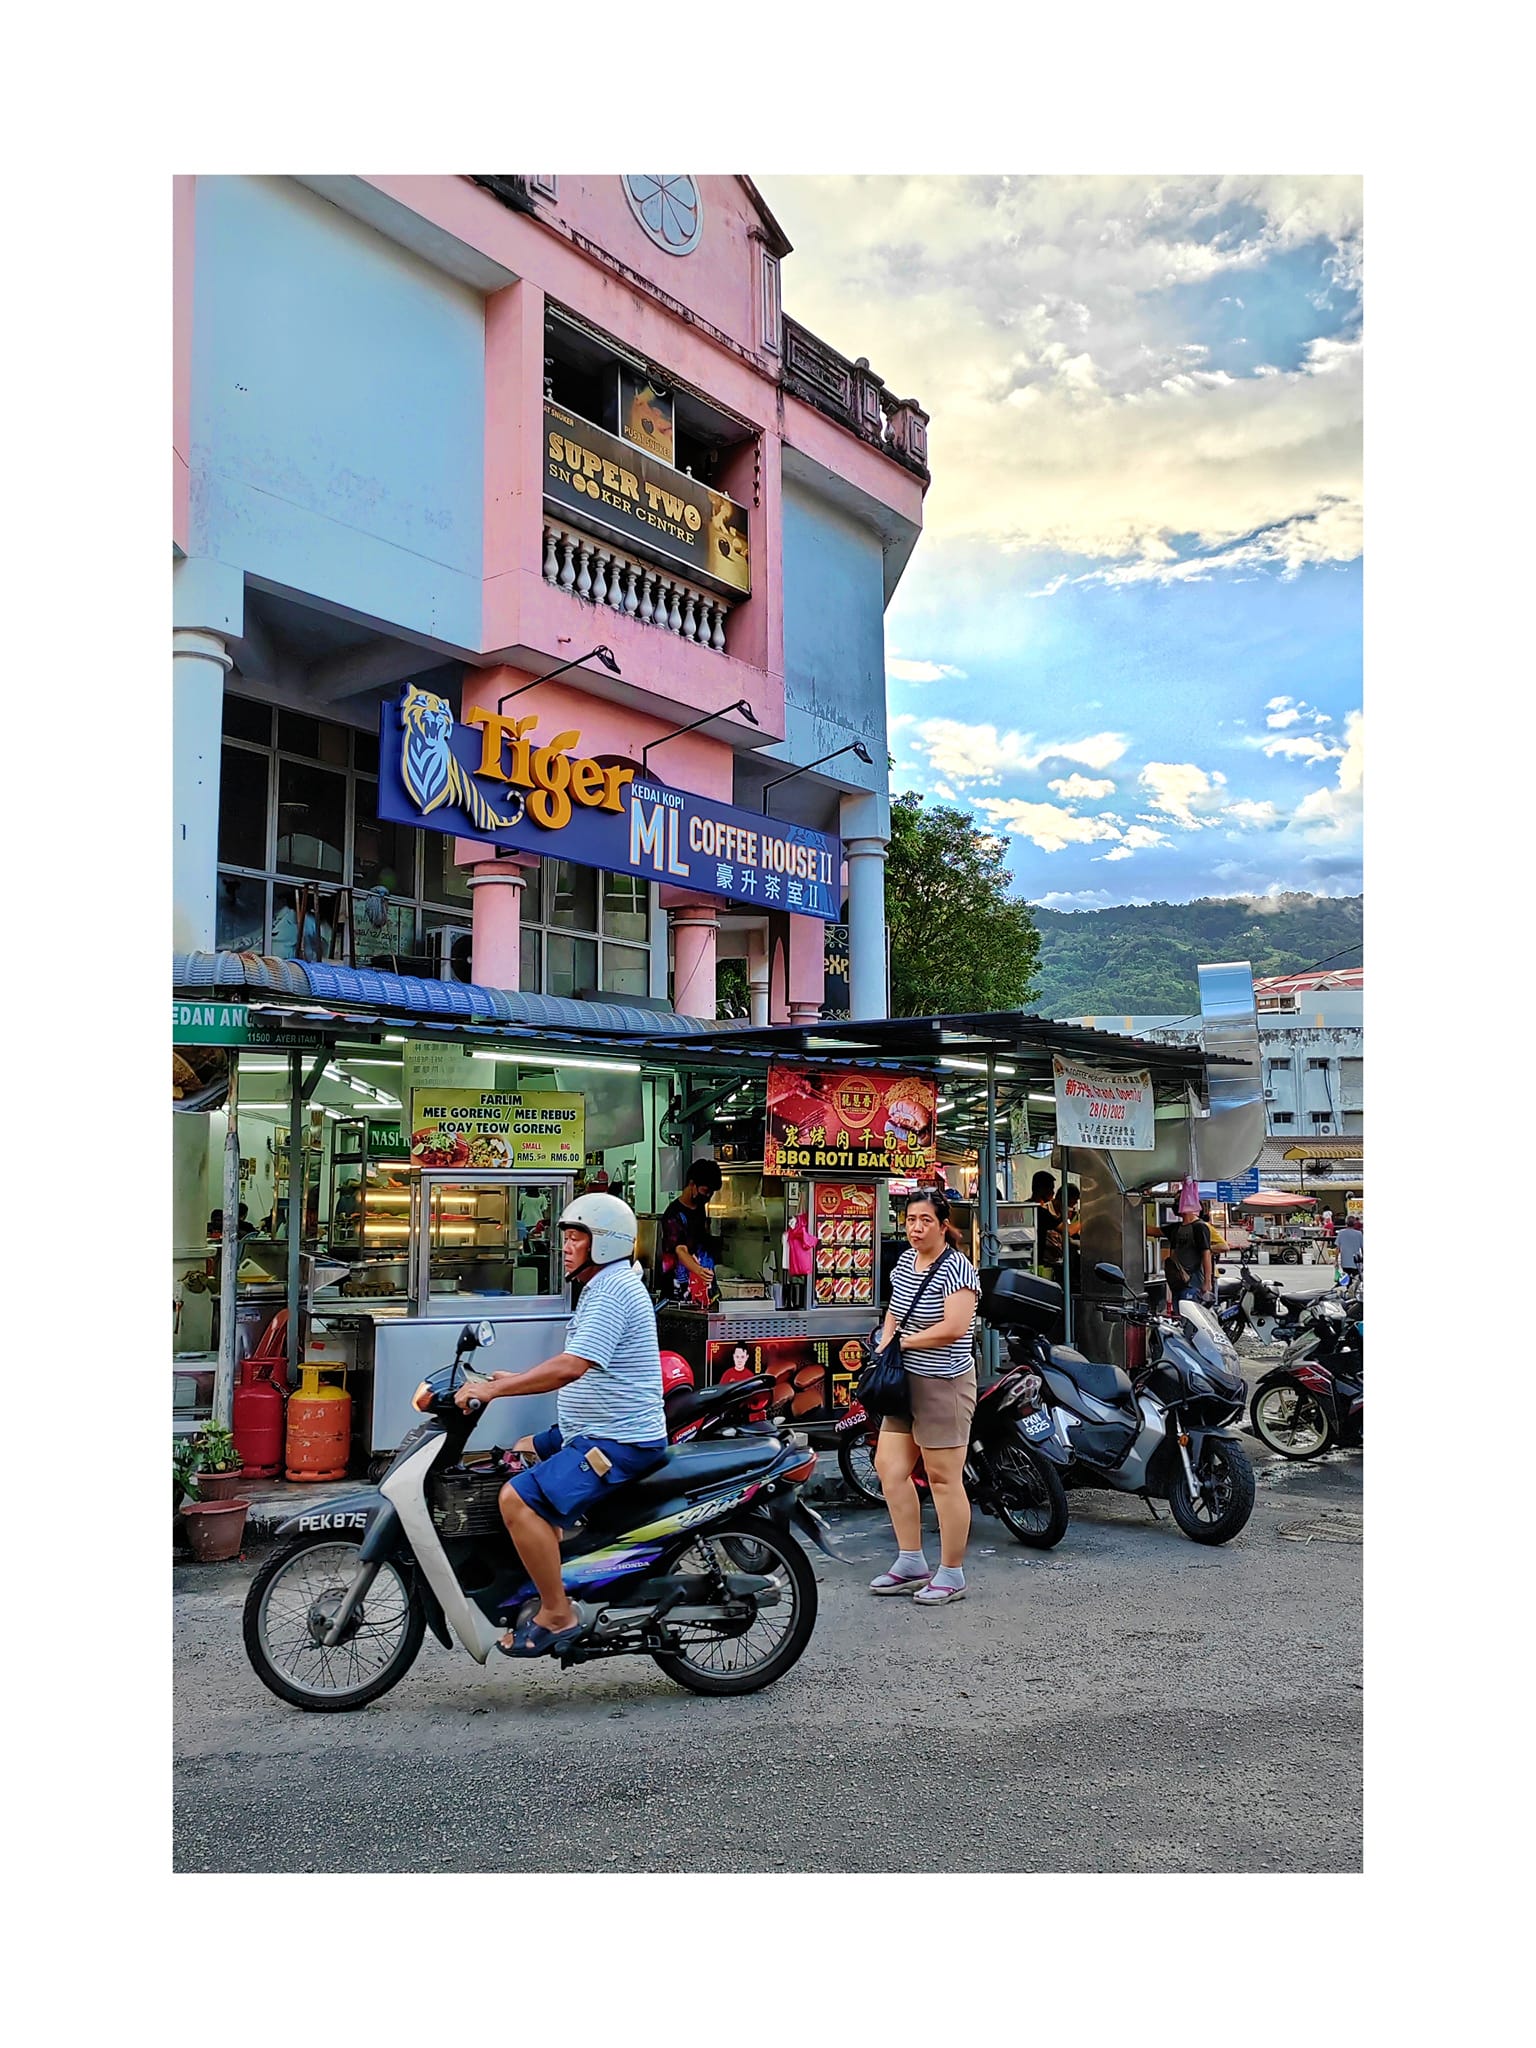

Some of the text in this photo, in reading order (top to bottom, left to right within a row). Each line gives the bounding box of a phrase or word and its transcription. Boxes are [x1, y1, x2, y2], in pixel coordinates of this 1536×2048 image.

[624, 425, 670, 456] PUSAT SNUKE
[549, 432, 640, 501] SUPER
[549, 464, 695, 546] SNOOKER CENTRE
[465, 705, 635, 830] Tiger
[631, 783, 684, 810] KEDAI KOPI
[629, 796, 690, 877] ML
[689, 815, 758, 867] COFFEE
[762, 835, 817, 881] HOUSE
[247, 1033, 317, 1043] 11500 AYER ITAM
[480, 1094, 522, 1105] FARLIM
[423, 1107, 447, 1118] MEE
[450, 1108, 501, 1119] GORENG
[515, 1109, 538, 1120] MEE
[541, 1110, 576, 1121] REBUS
[1089, 1102, 1125, 1119] 28/6/2023
[438, 1122, 561, 1134] KOAY TEOW GORENG
[371, 1130, 400, 1146] NASI
[783, 1125, 921, 1151] 炭烤肉干面包
[551, 1153, 579, 1161] RM6.00
[776, 1151, 926, 1168] BBQ ROTI BAK KUA
[1022, 1412, 1042, 1427] PKN
[1026, 1419, 1050, 1435] 9325
[618, 1561, 650, 1570] HONDA
